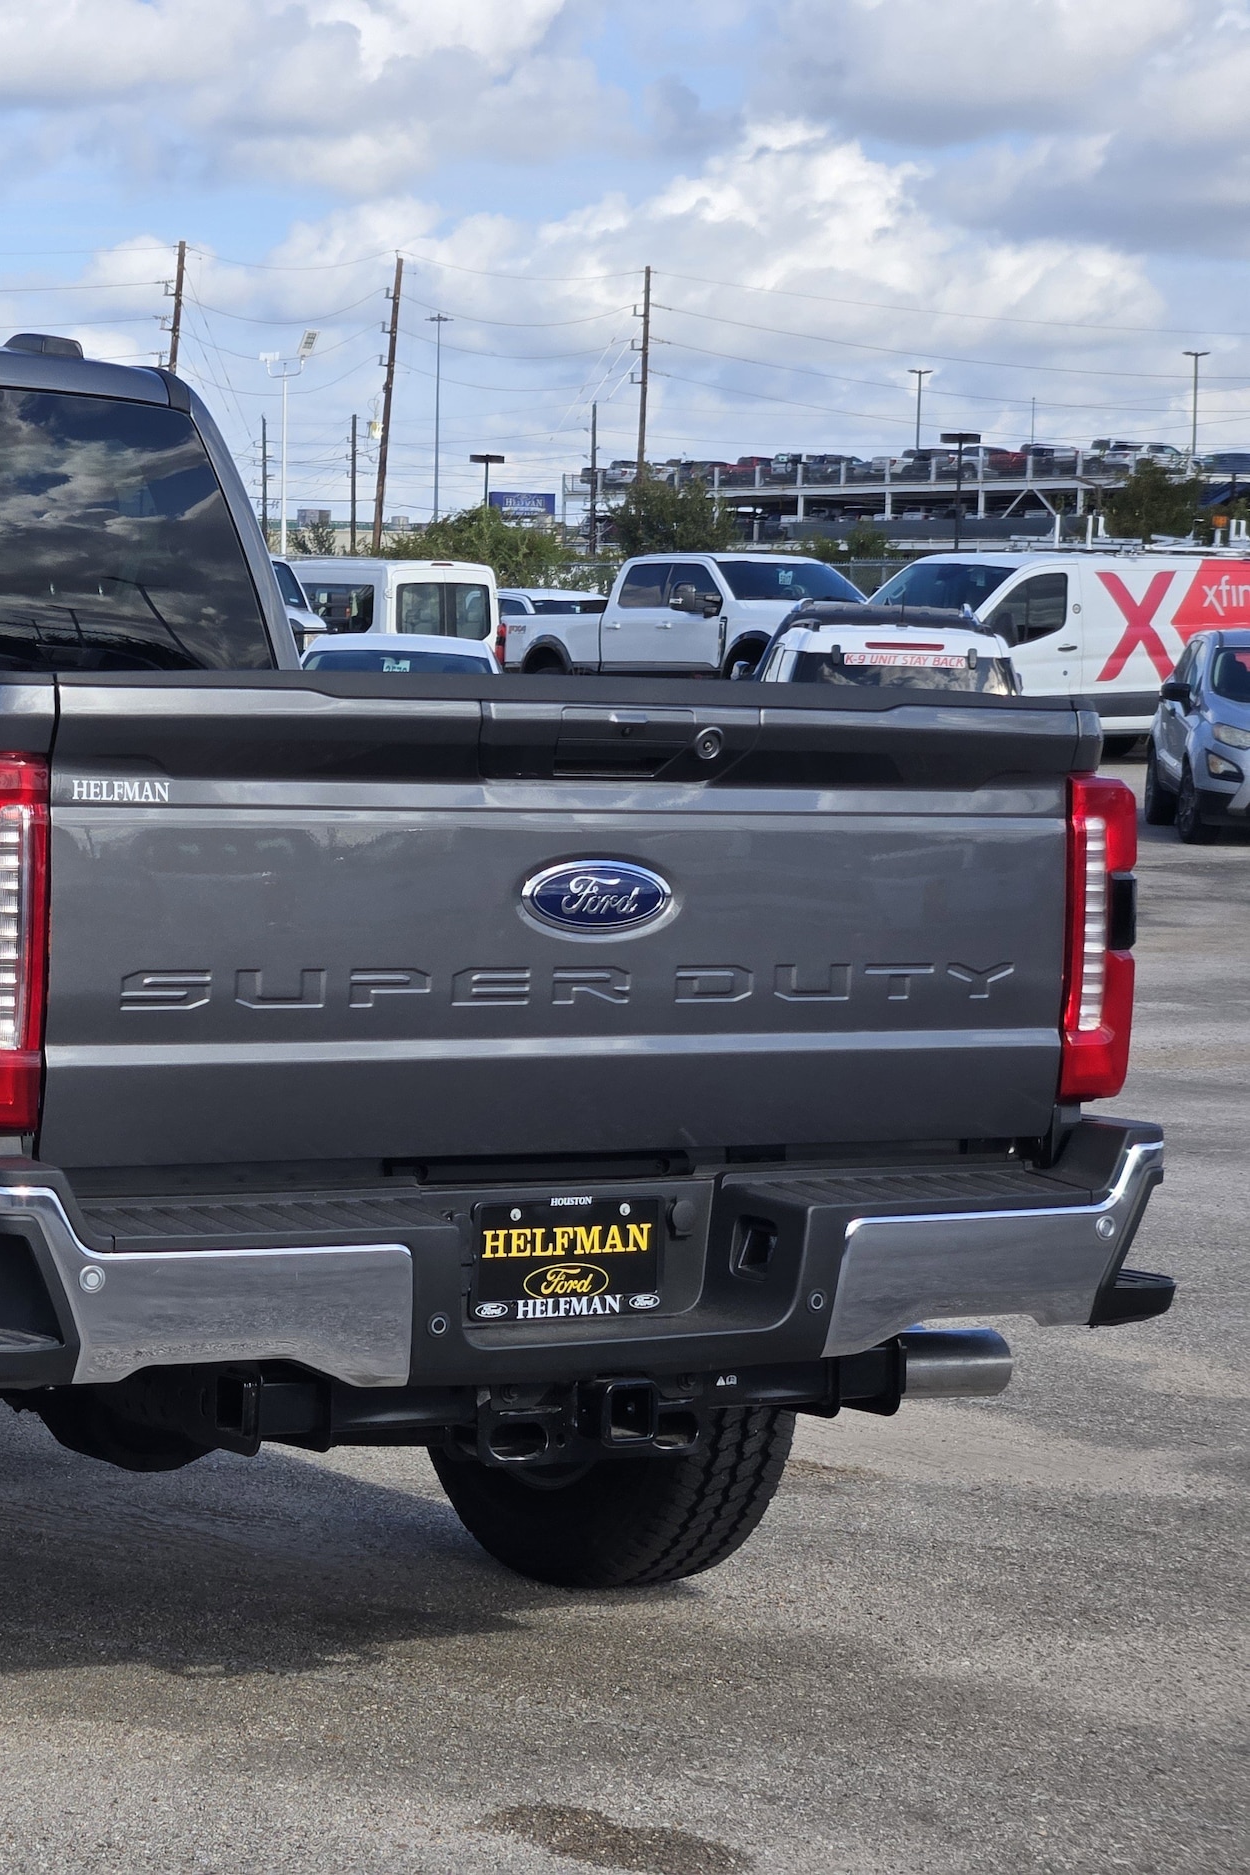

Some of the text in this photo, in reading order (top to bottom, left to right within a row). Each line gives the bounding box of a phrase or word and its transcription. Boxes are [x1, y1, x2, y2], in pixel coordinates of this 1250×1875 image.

[845, 654, 964, 668] K-9 UNIT STAY BACK
[72, 780, 169, 802] HELFMAN
[561, 876, 640, 915] Ford
[121, 963, 1015, 1010] SUPER DUTY
[550, 1196, 593, 1207] HOUSTON
[482, 1223, 652, 1258] HELFMAN
[541, 1268, 594, 1295] Ford
[516, 1295, 622, 1319] HELFMAN
